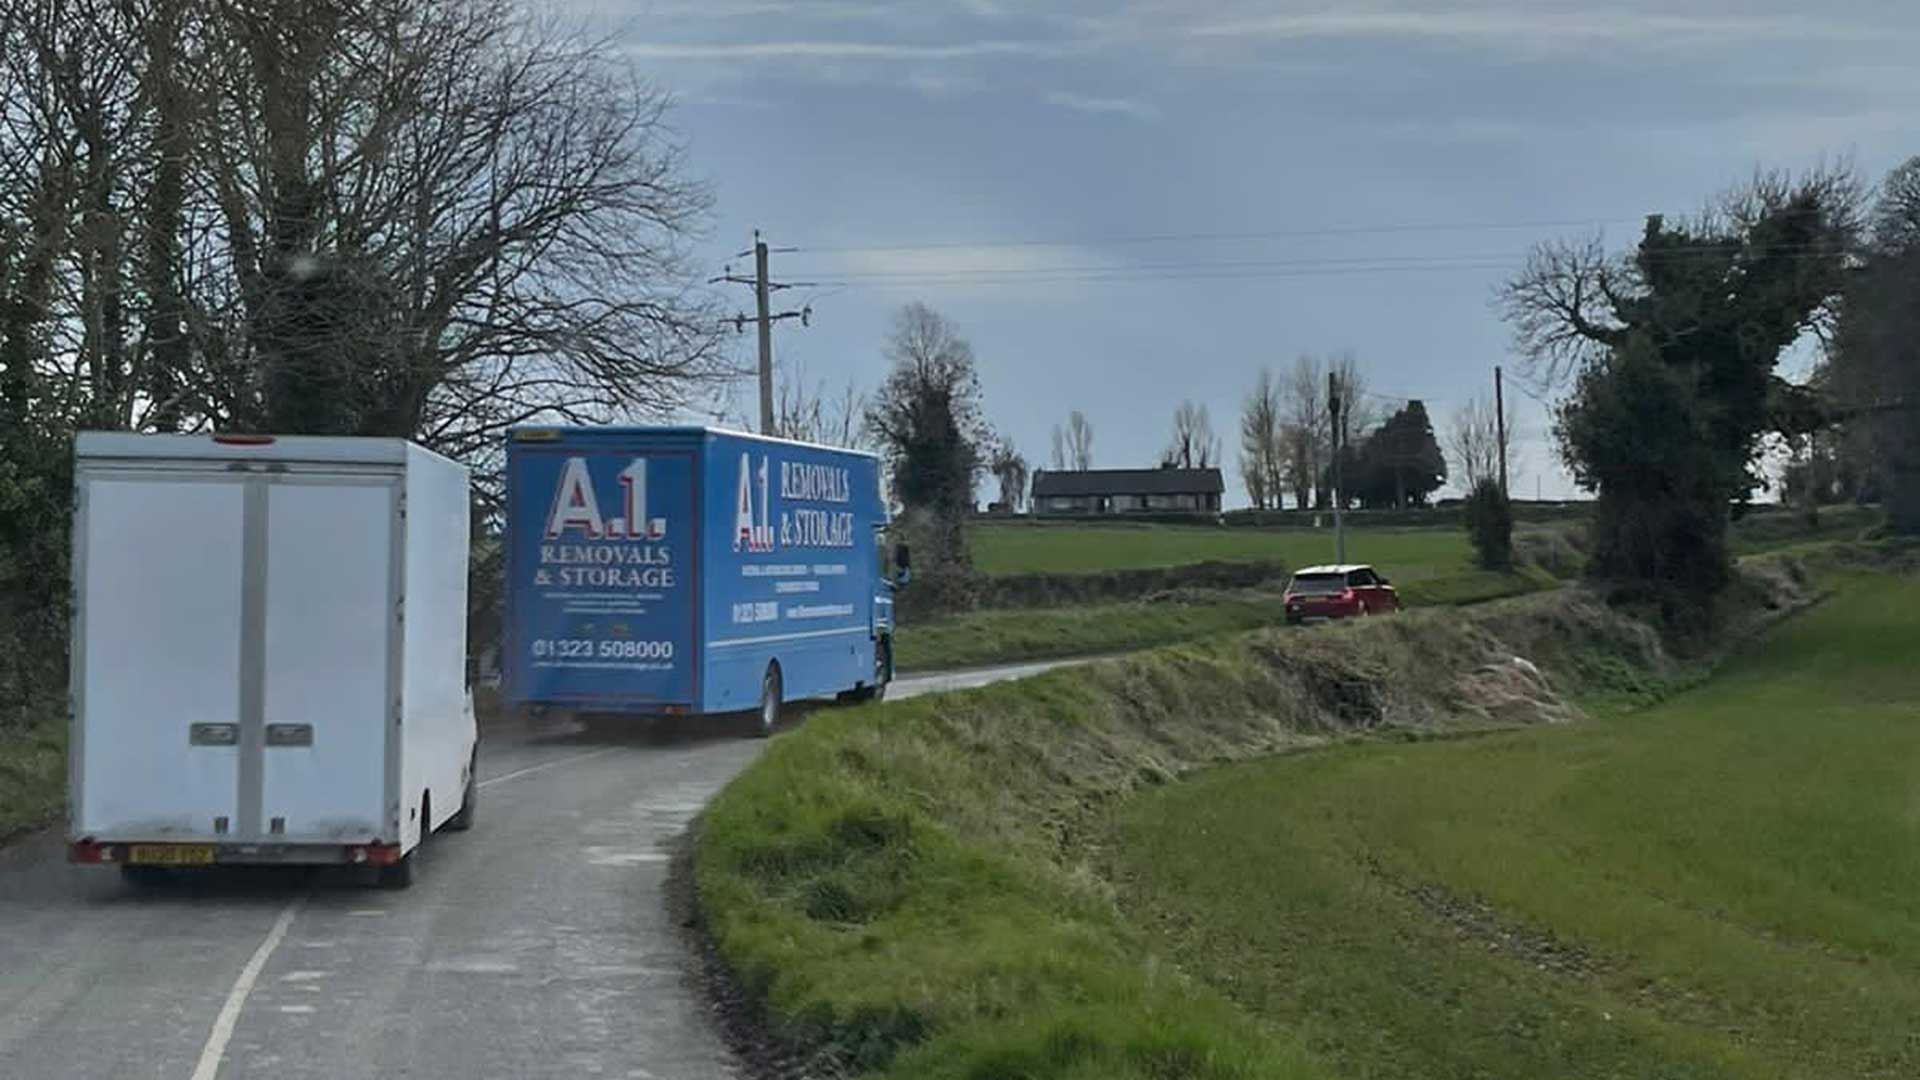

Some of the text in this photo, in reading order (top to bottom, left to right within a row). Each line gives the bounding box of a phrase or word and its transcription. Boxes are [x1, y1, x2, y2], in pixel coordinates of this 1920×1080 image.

[781, 461, 849, 503] REMOVALS
[781, 503, 854, 547] & STORAGE
[541, 545, 670, 564] REMOVALS
[534, 568, 675, 587] & STORAGE
[532, 639, 673, 658] 01323 508000
